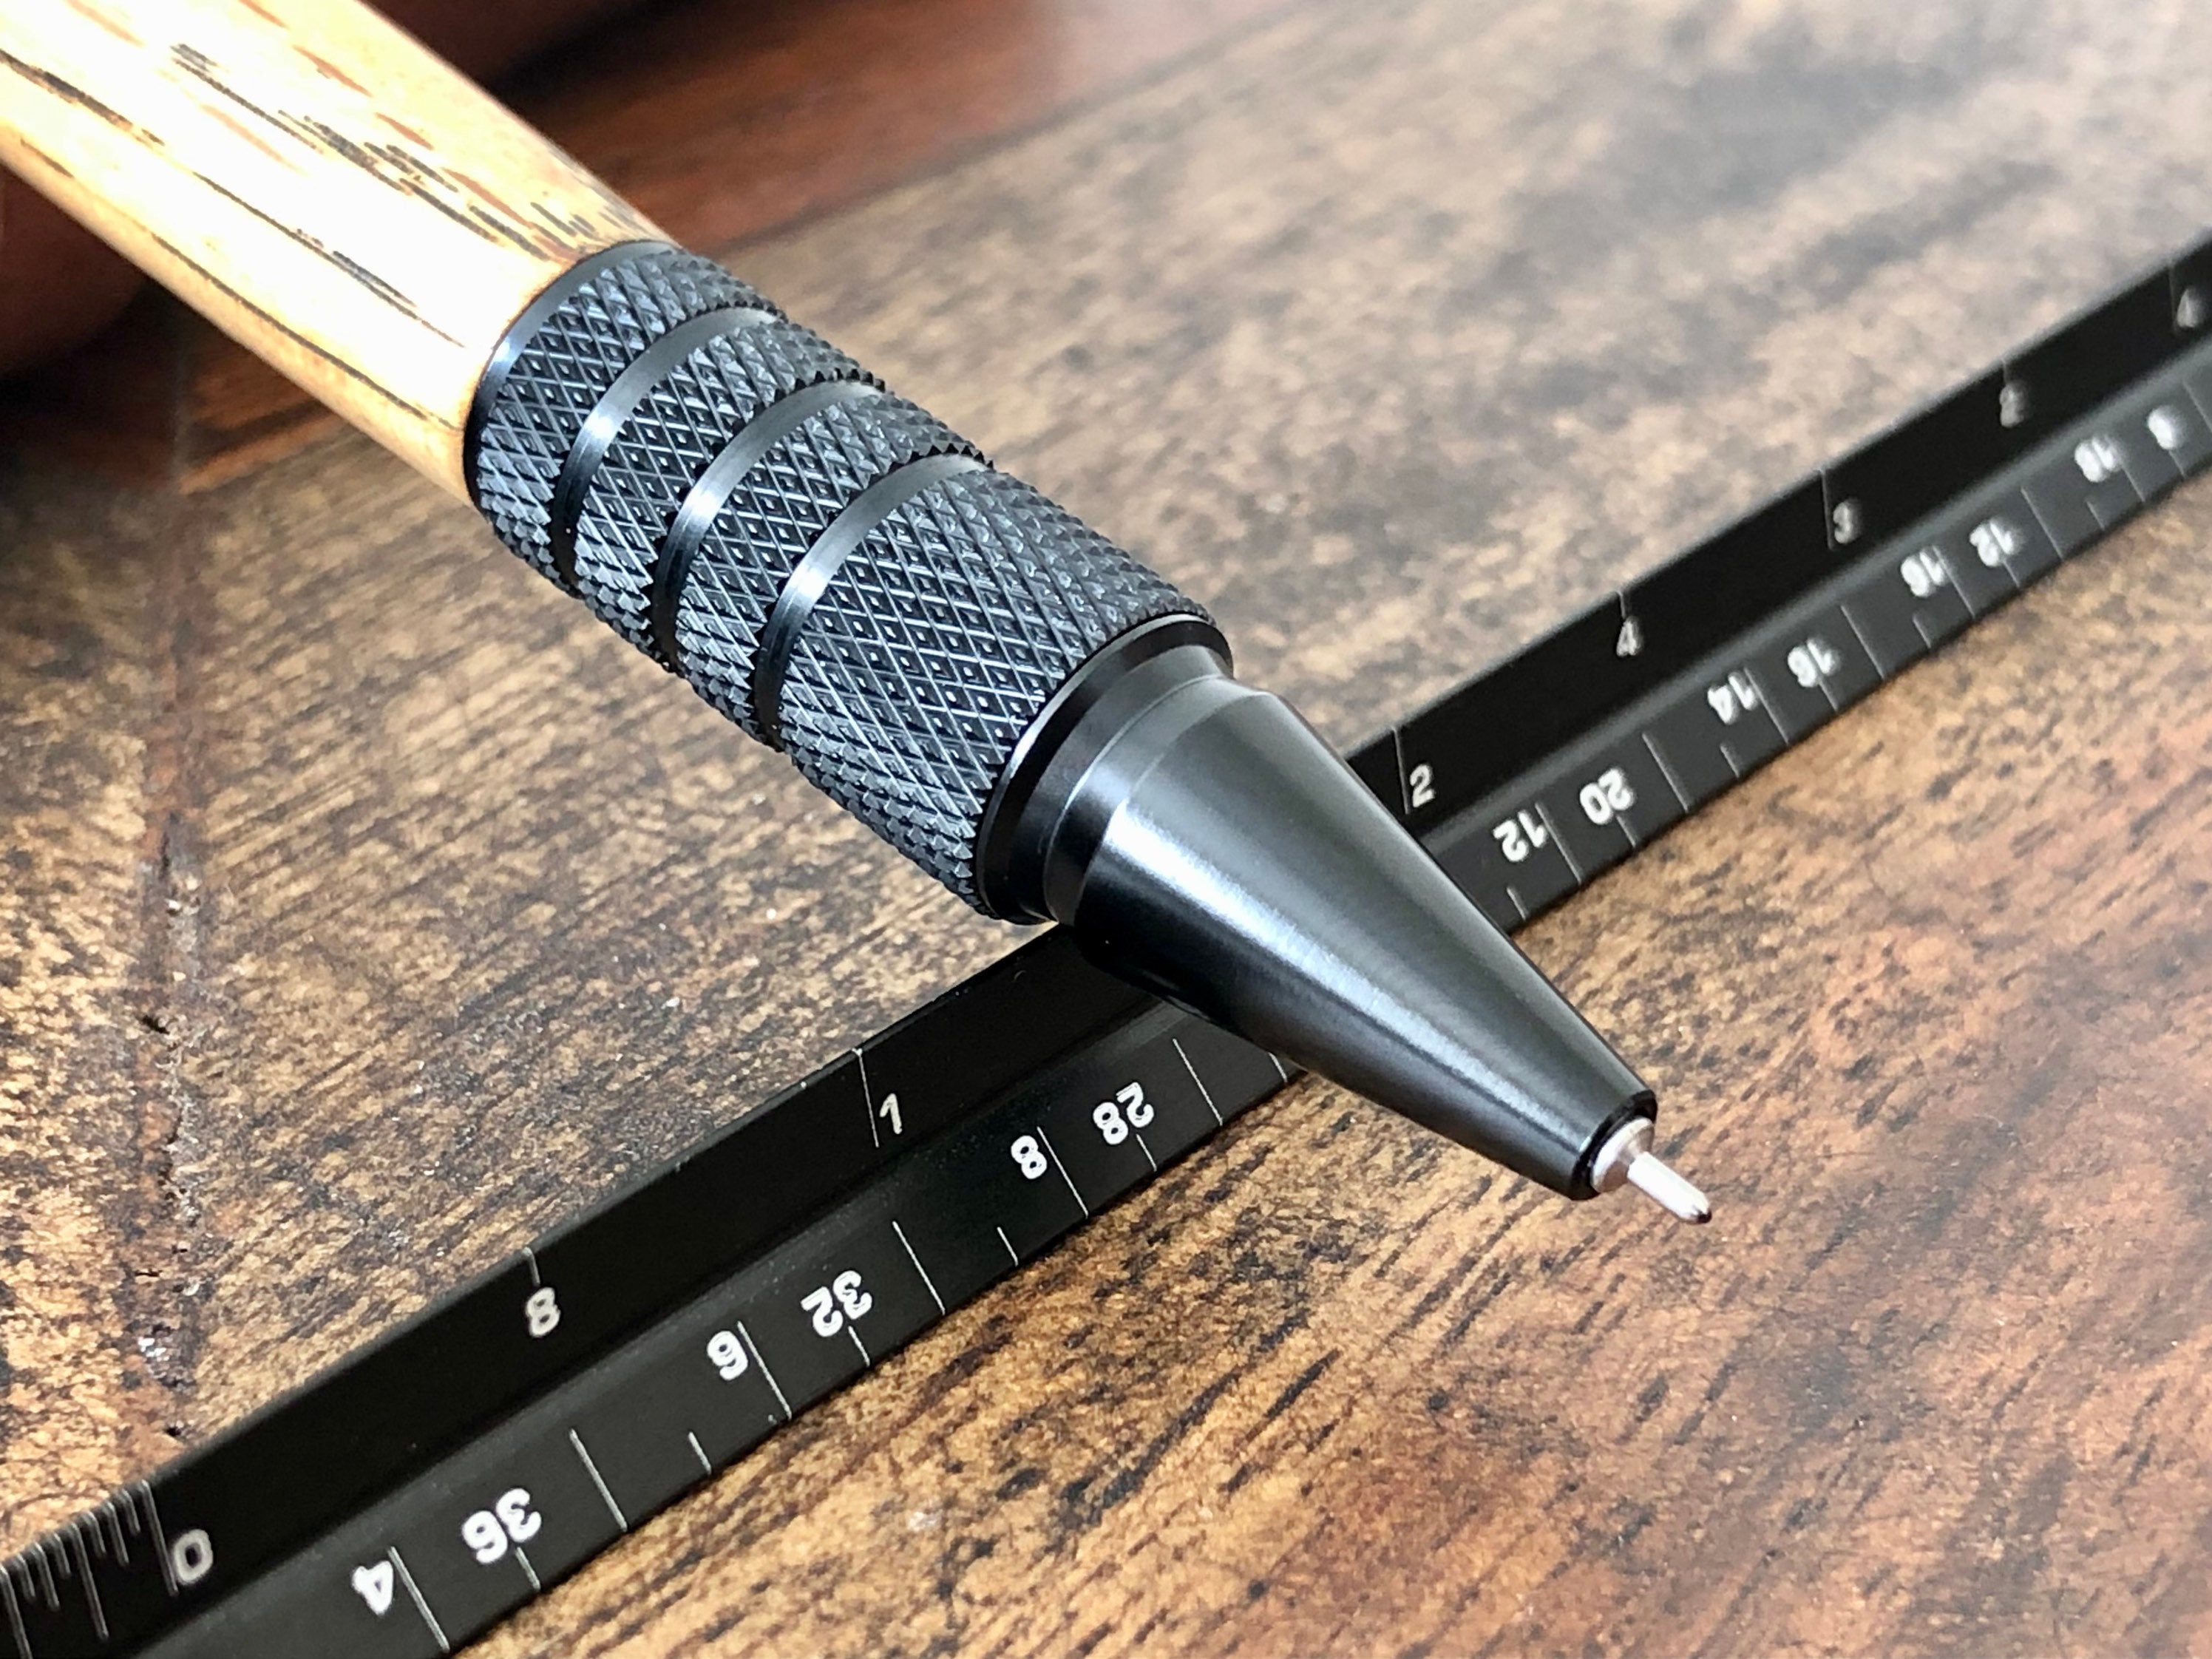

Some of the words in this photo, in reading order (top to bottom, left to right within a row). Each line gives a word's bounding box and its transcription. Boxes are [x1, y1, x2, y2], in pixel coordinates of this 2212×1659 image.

[1832, 498, 1862, 544] 3
[1616, 616, 1644, 657] 4
[1707, 671, 1759, 725] 14
[1409, 763, 1435, 808] 2
[1579, 767, 1635, 826] 20
[1492, 810, 1547, 864] 12
[879, 1092, 903, 1136] 1
[1092, 1082, 1155, 1145] 28
[1010, 1135, 1048, 1180] 8
[525, 1286, 561, 1338] 8
[801, 1269, 872, 1337] 32
[706, 1329, 749, 1381] 6
[461, 1487, 542, 1564] 36
[172, 1528, 214, 1586] 0
[352, 1560, 395, 1615] 4
